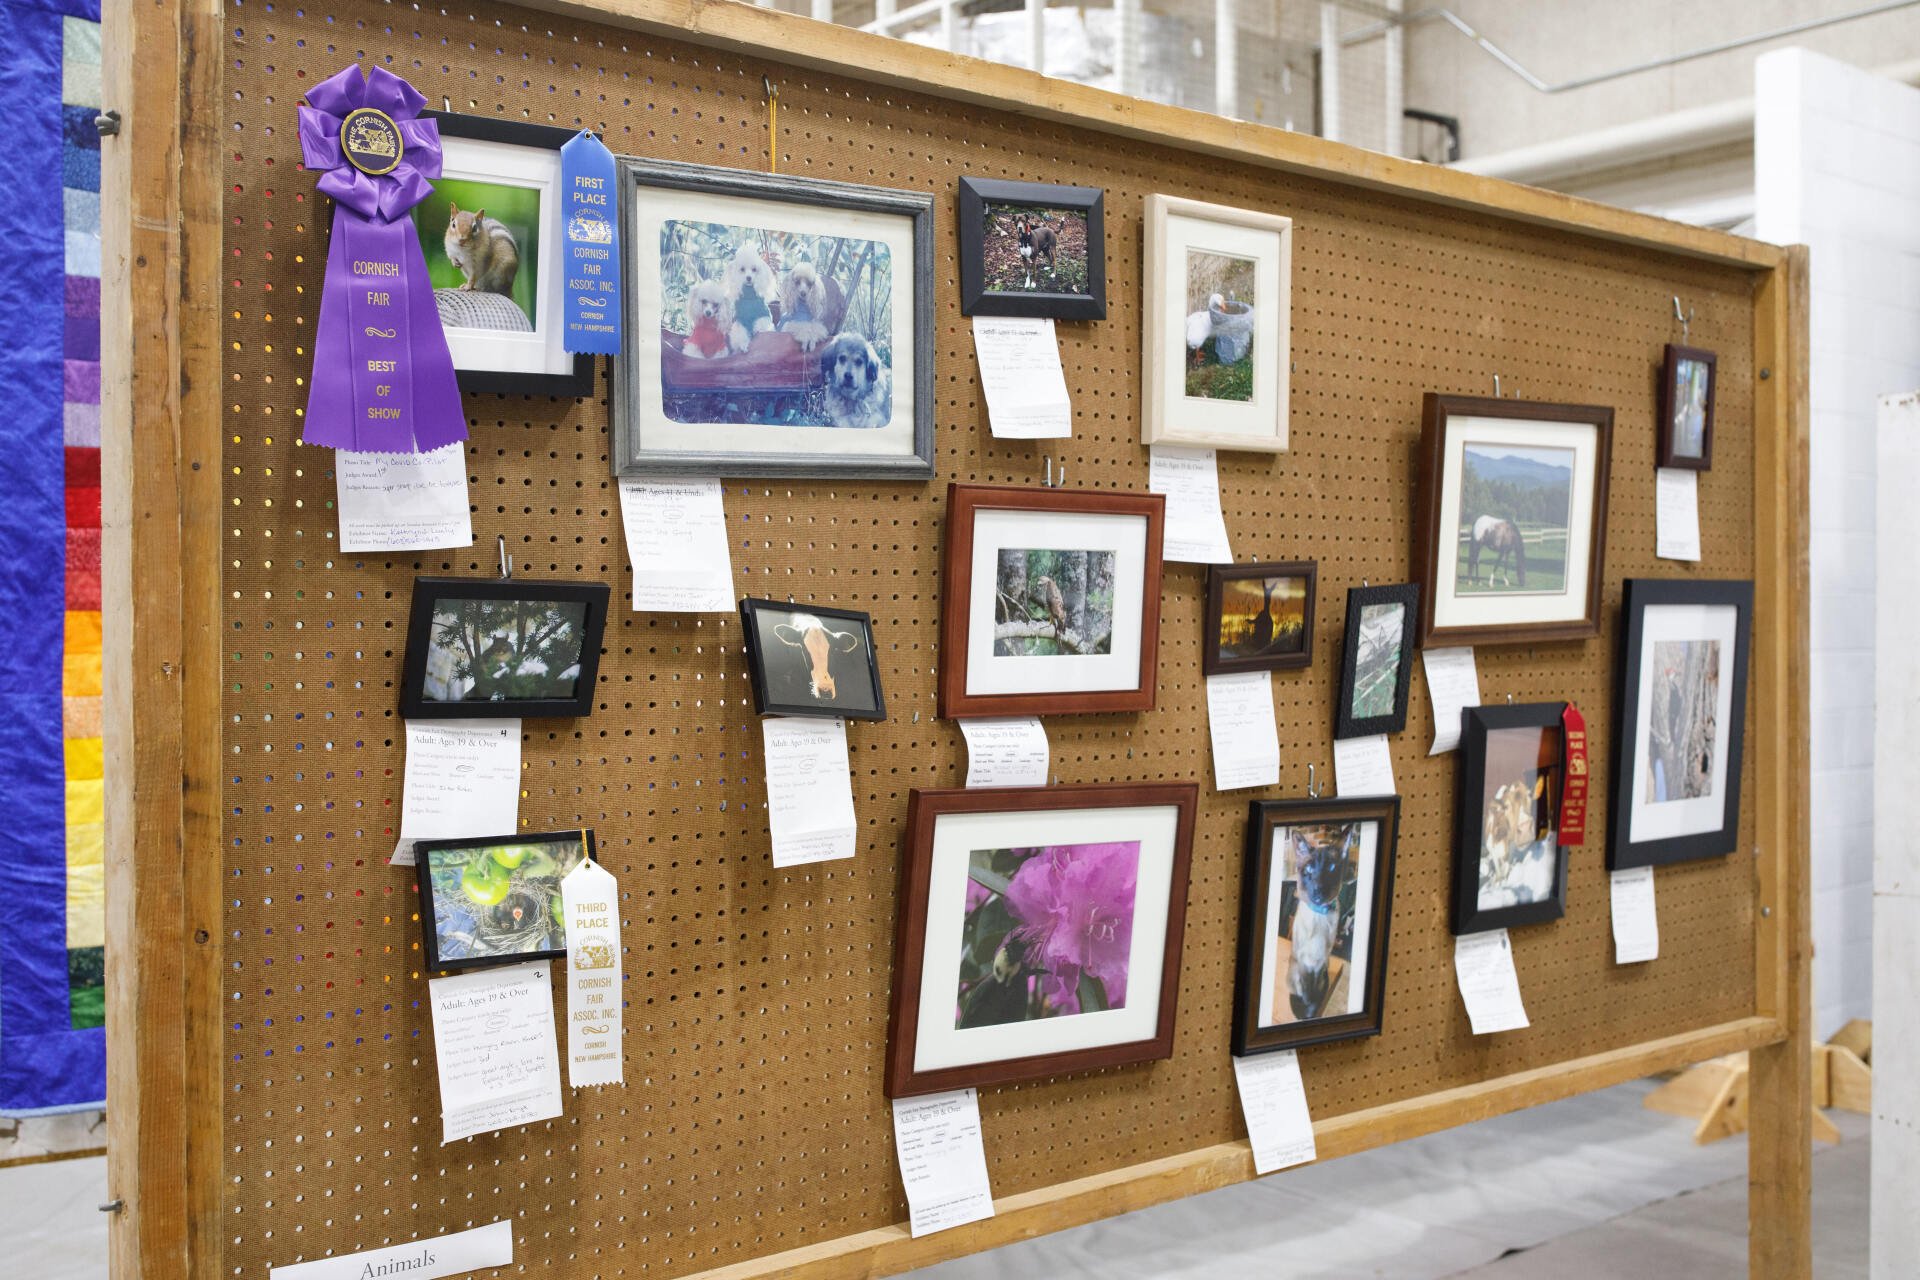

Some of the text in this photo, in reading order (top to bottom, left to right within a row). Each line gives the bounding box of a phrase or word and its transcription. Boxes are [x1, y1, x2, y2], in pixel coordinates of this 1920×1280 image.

[355, 116, 388, 131] CORNISH
[575, 176, 604, 189] FIRST
[573, 192, 607, 205] PLACE
[574, 247, 609, 260] CORNISH
[353, 260, 399, 277] CORNISH
[583, 263, 601, 275] FAIR
[569, 279, 616, 293] ASSOC. INC.
[367, 291, 390, 306] FAIR
[580, 311, 604, 320] CORNISH
[570, 323, 615, 333] NEW HAMPSHIRE
[367, 360, 396, 372] BEST
[376, 385, 391, 397] OF
[367, 407, 401, 420] SHOW
[500, 729, 507, 737] 4
[414, 736, 436, 745] Adult:
[438, 738, 455, 747] Ages
[457, 738, 466, 746] 19
[478, 739, 498, 748] Over
[575, 902, 607, 913] THIRD
[576, 917, 609, 929] PLACE
[533, 971, 543, 979] 2
[578, 977, 612, 990] CORNISH
[440, 988, 529, 1011] Adult: Ages 19 & Over
[586, 993, 604, 1005] FAIR
[573, 1008, 617, 1021] ASSOC. INC.
[584, 1041, 607, 1050] CORNISH
[574, 1052, 617, 1063] NEW HAMPSHIRE
[361, 1250, 436, 1280] Animals
